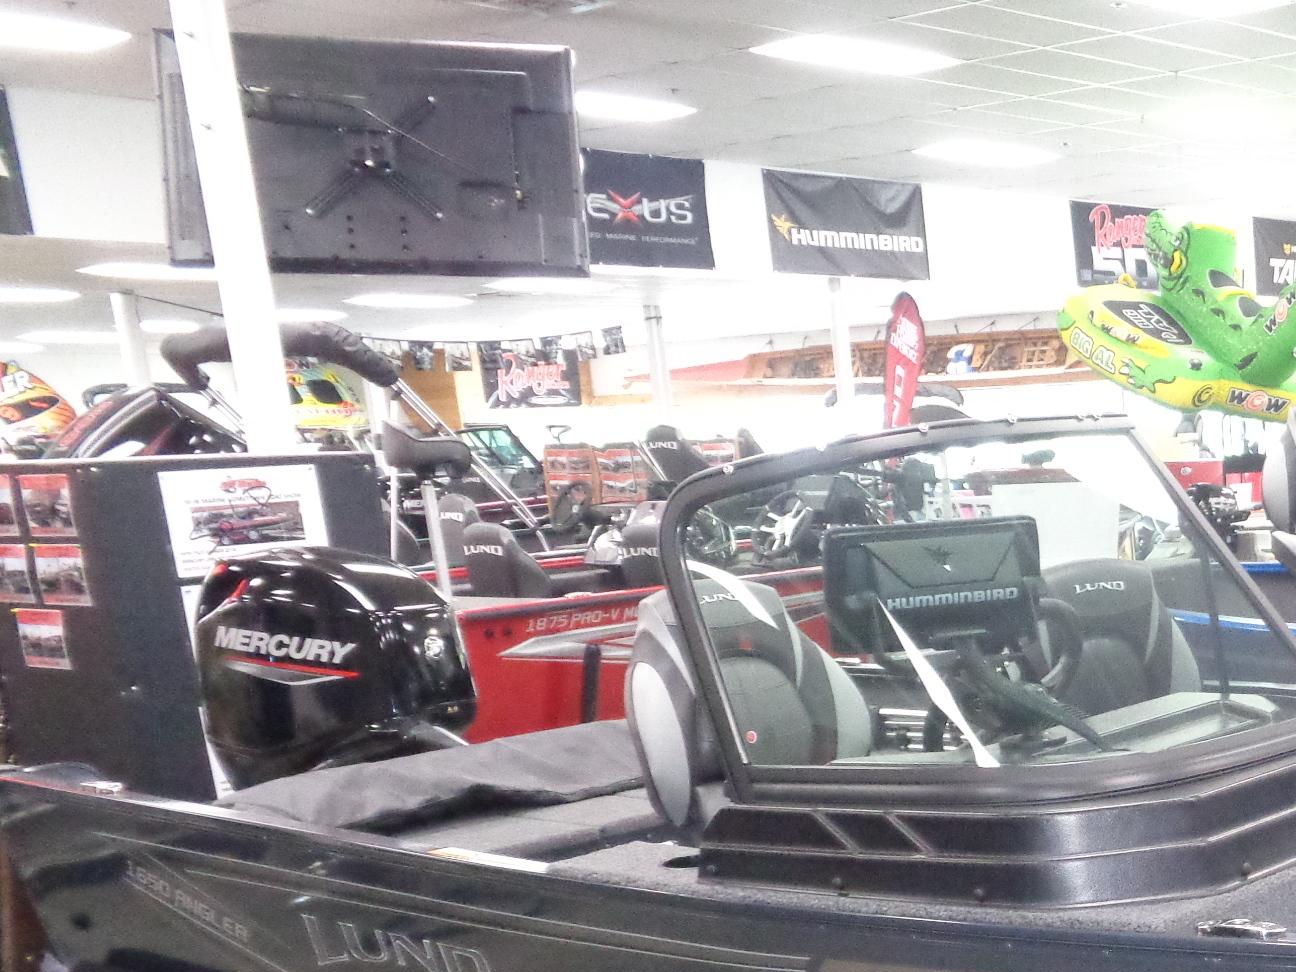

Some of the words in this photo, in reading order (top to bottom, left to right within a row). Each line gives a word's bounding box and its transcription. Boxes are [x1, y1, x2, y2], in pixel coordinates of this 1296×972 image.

[585, 189, 695, 225] EXUS
[790, 228, 925, 253] HUMMINBIRD
[1071, 330, 1093, 357] BIG
[1093, 346, 1115, 373] AL
[1227, 388, 1290, 413] WOW
[463, 545, 504, 556] LUND
[887, 586, 1019, 610] HUMMINBIRD
[1074, 580, 1125, 595] LUND
[526, 615, 568, 632] 1875
[570, 609, 620, 628] PRO-V
[214, 626, 356, 664] MERCURY
